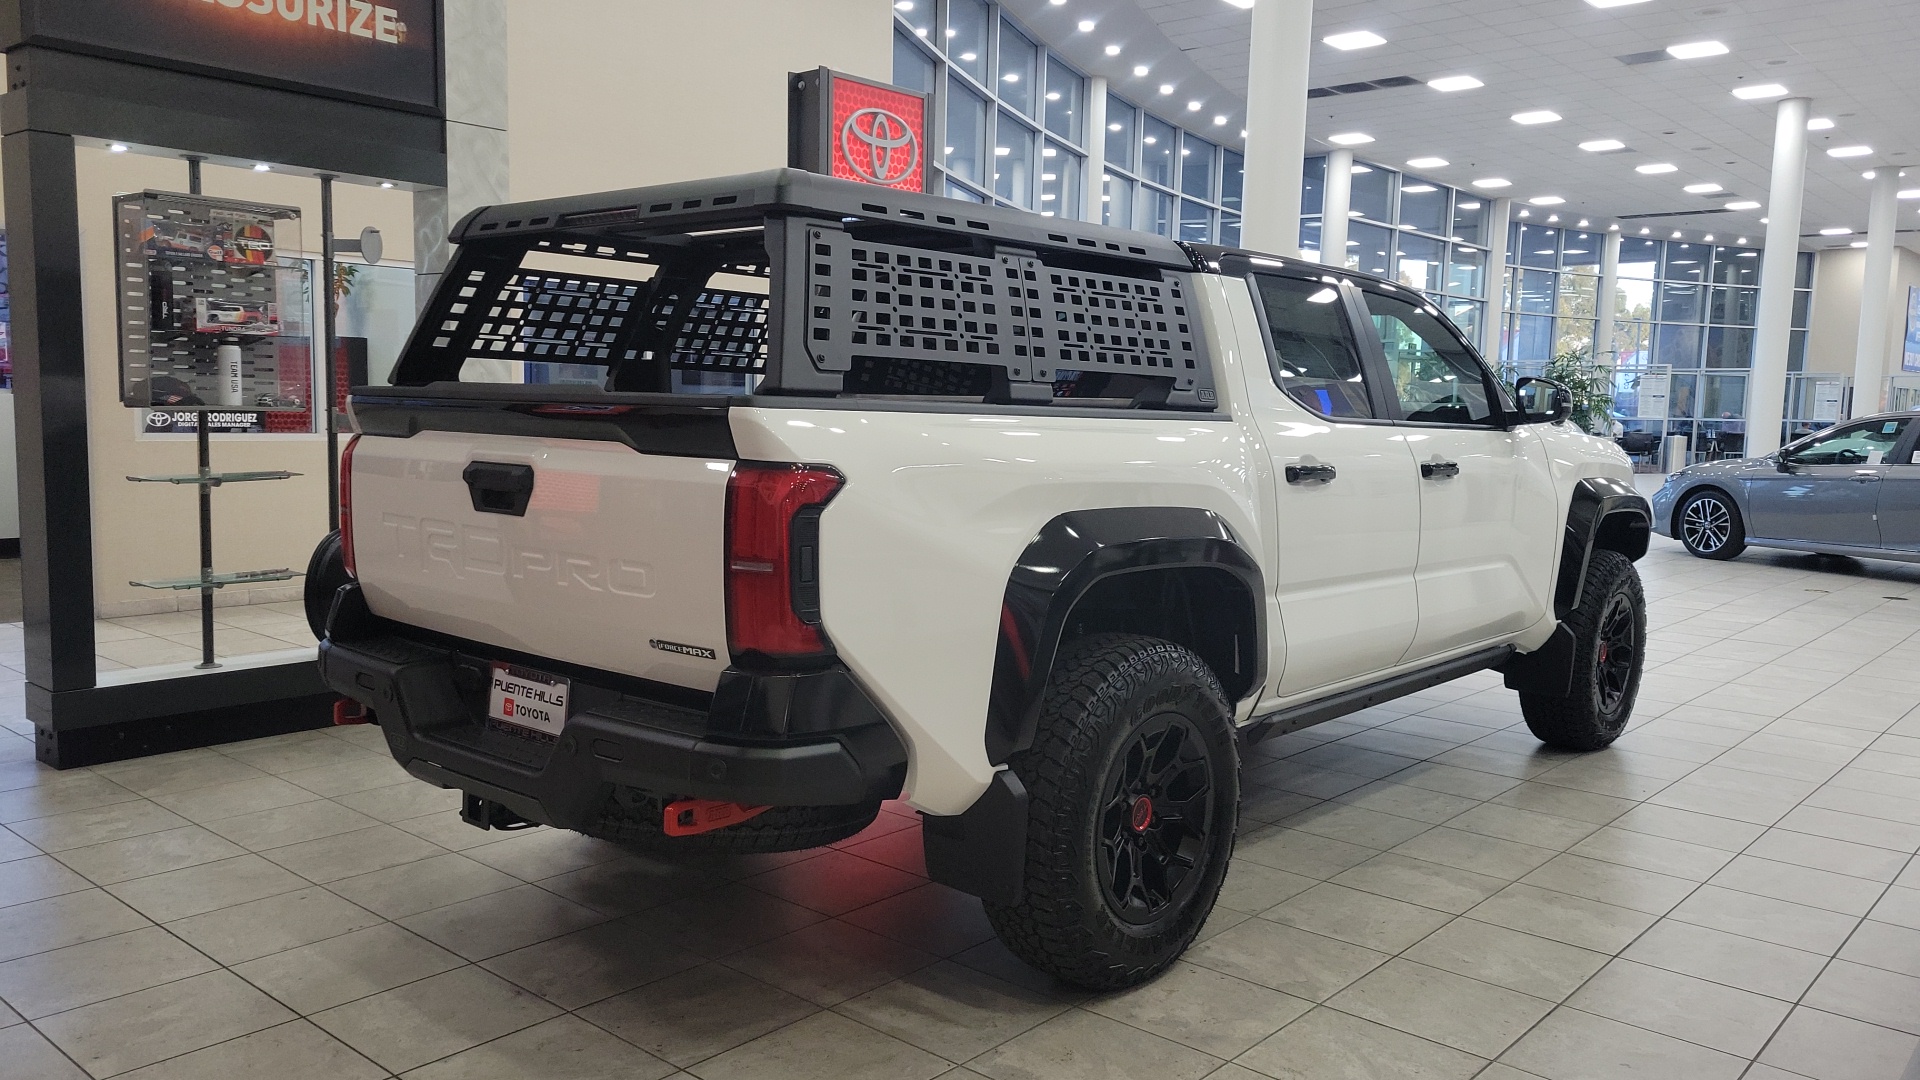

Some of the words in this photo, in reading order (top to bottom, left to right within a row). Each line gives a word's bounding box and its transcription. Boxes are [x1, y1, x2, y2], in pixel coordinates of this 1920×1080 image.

[230, 361, 238, 378] TEAM
[172, 412, 199, 422] JORG
[382, 511, 506, 580] TRD
[510, 546, 657, 599] PRO
[493, 678, 534, 699] PUENTE
[533, 688, 564, 707] HILLS
[515, 704, 551, 723] TOYOTA
